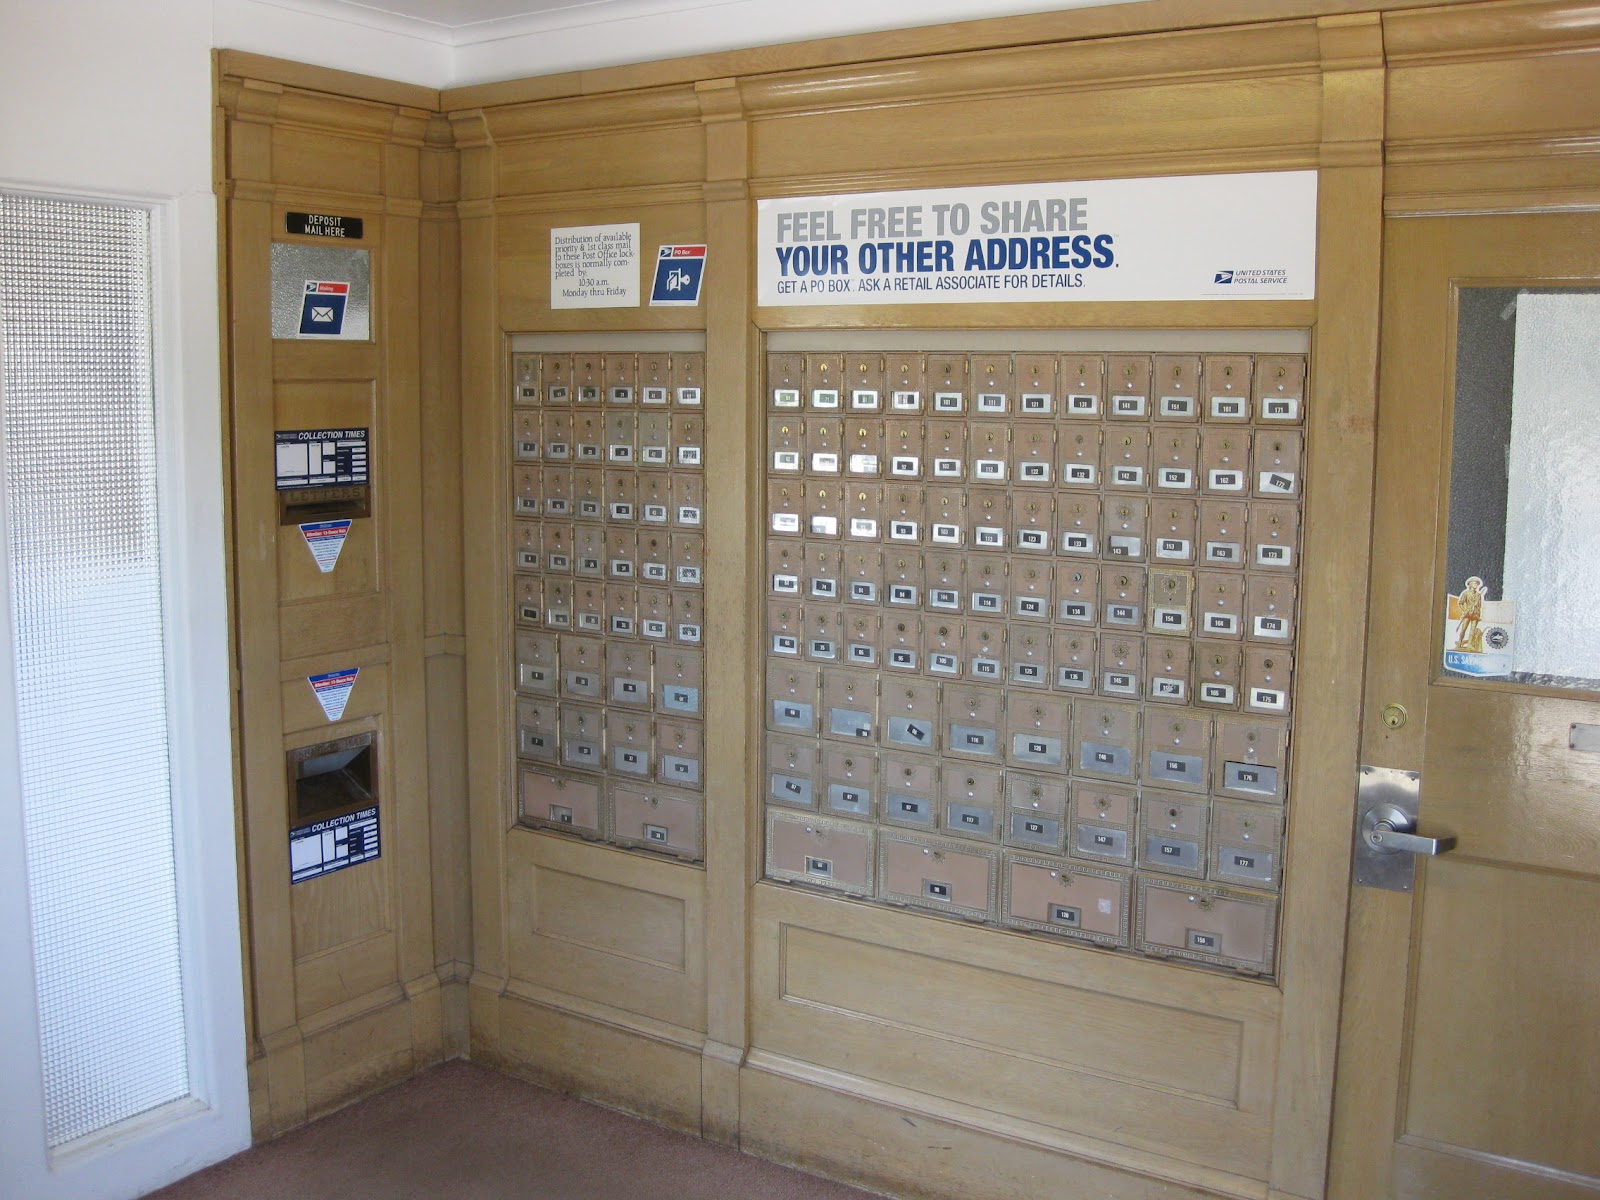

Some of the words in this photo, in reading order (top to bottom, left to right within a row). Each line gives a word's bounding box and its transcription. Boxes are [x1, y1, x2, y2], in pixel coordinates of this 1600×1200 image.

[309, 215, 342, 227] DEPOSIT
[777, 210, 842, 243] FEEL
[850, 205, 922, 239] FREE
[932, 203, 970, 236] TO
[980, 197, 1088, 235] SHARE
[305, 225, 323, 236] MAIL
[325, 227, 345, 237] HERE
[555, 235, 593, 244] Distribution
[594, 233, 602, 242] of
[603, 232, 632, 241] available
[555, 244, 579, 253] priority
[587, 243, 596, 251] 1st
[598, 242, 614, 250] class
[615, 240, 631, 249] mail
[563, 252, 581, 260] these
[582, 251, 596, 260] Post
[597, 249, 617, 259] Office
[619, 248, 635, 258] lock-
[775, 244, 849, 277] YOUR
[858, 240, 954, 275] OTHER
[555, 260, 573, 269] boxes
[575, 260, 581, 268] is
[582, 258, 612, 269] normally
[614, 259, 630, 267] com-
[555, 269, 574, 280] pleted
[777, 280, 797, 294] GET
[800, 280, 807, 293] A
[811, 280, 825, 293] PO
[858, 278, 881, 292] ASK
[883, 278, 891, 291] A
[894, 277, 932, 291] RETAIL
[936, 275, 1000, 290] ASSOCIATE
[1004, 274, 1028, 288] FOR
[1032, 273, 1085, 288] DETAILS.
[562, 289, 588, 298] Monday
[590, 288, 605, 296] thru
[606, 287, 626, 297] Friday
[298, 431, 343, 440] COLLECTION
[344, 430, 365, 438] TIMES
[1448, 655, 1460, 664] U.S.
[312, 814, 355, 832] COLLECTION
[356, 808, 376, 820] TIMES
